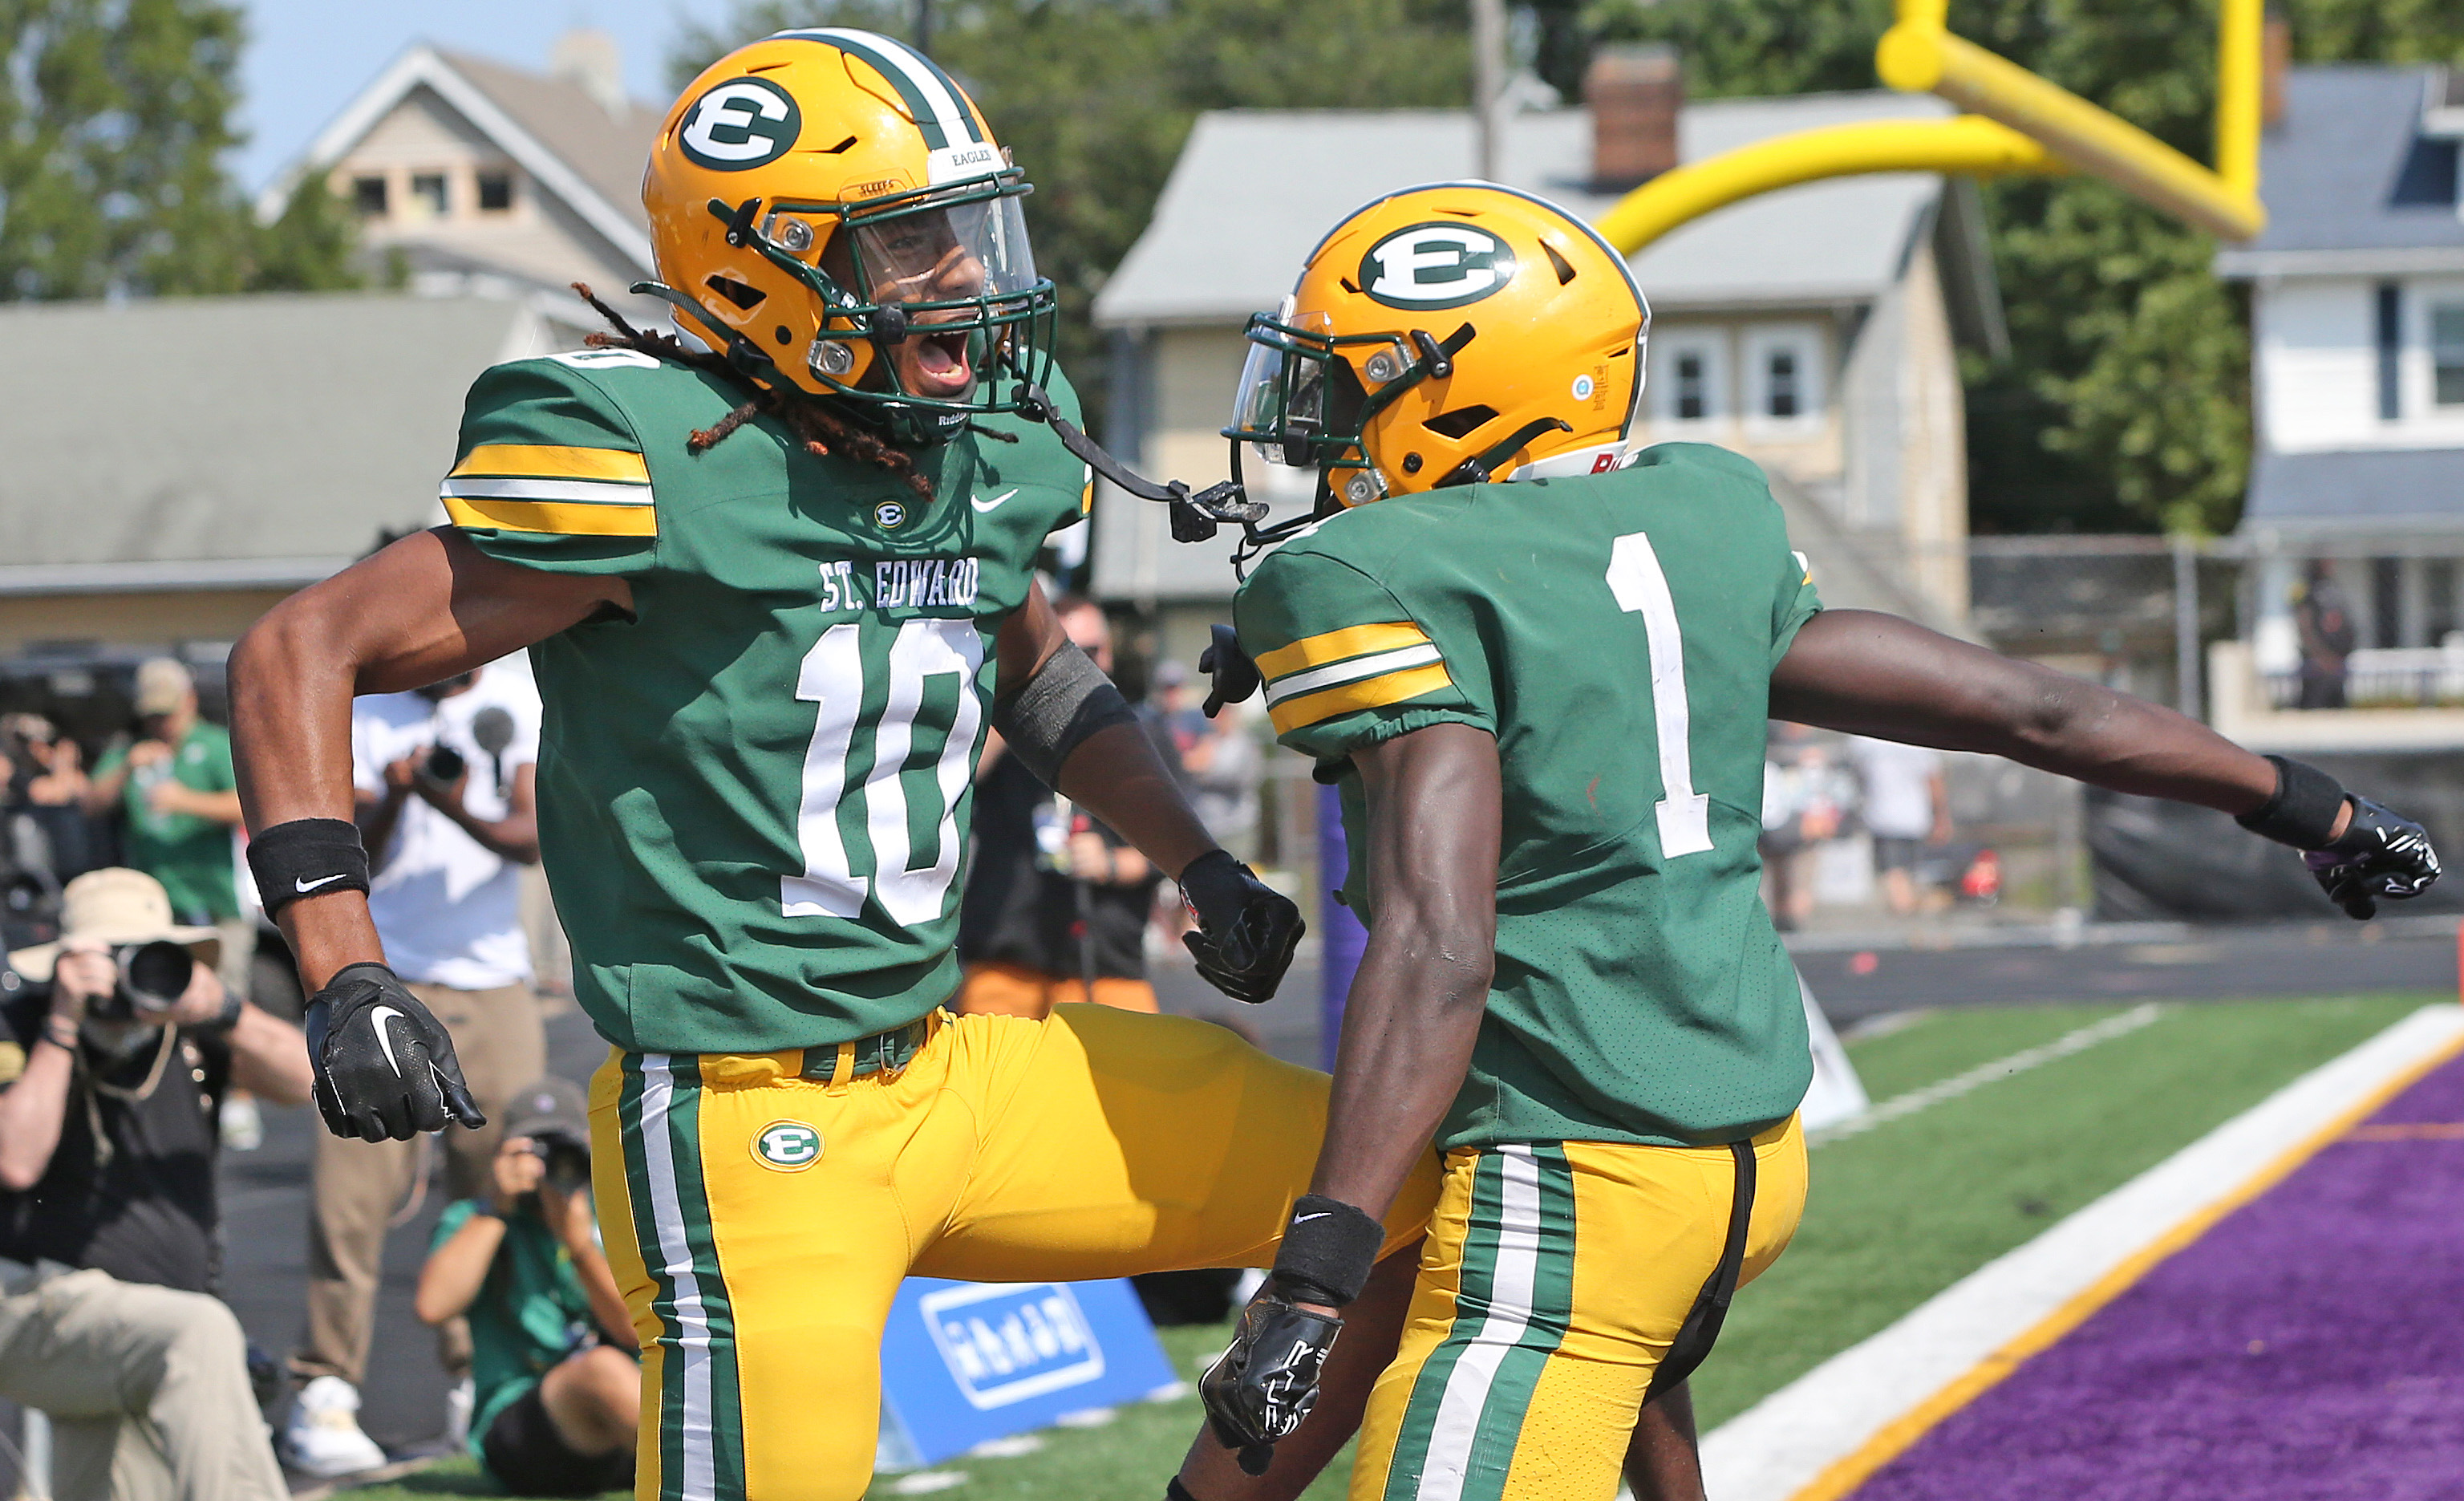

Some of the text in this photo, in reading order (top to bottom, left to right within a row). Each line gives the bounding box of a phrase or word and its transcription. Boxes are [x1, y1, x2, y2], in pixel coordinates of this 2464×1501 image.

[683, 83, 791, 160] E
[951, 148, 992, 167] EAGLES
[859, 179, 894, 194] SLEEFS
[1372, 226, 1496, 301] E
[877, 505, 902, 525] E
[819, 557, 980, 613] ST. EDWARD
[1605, 530, 1716, 860] 1
[780, 617, 985, 927] 10
[762, 1127, 815, 1162] E
